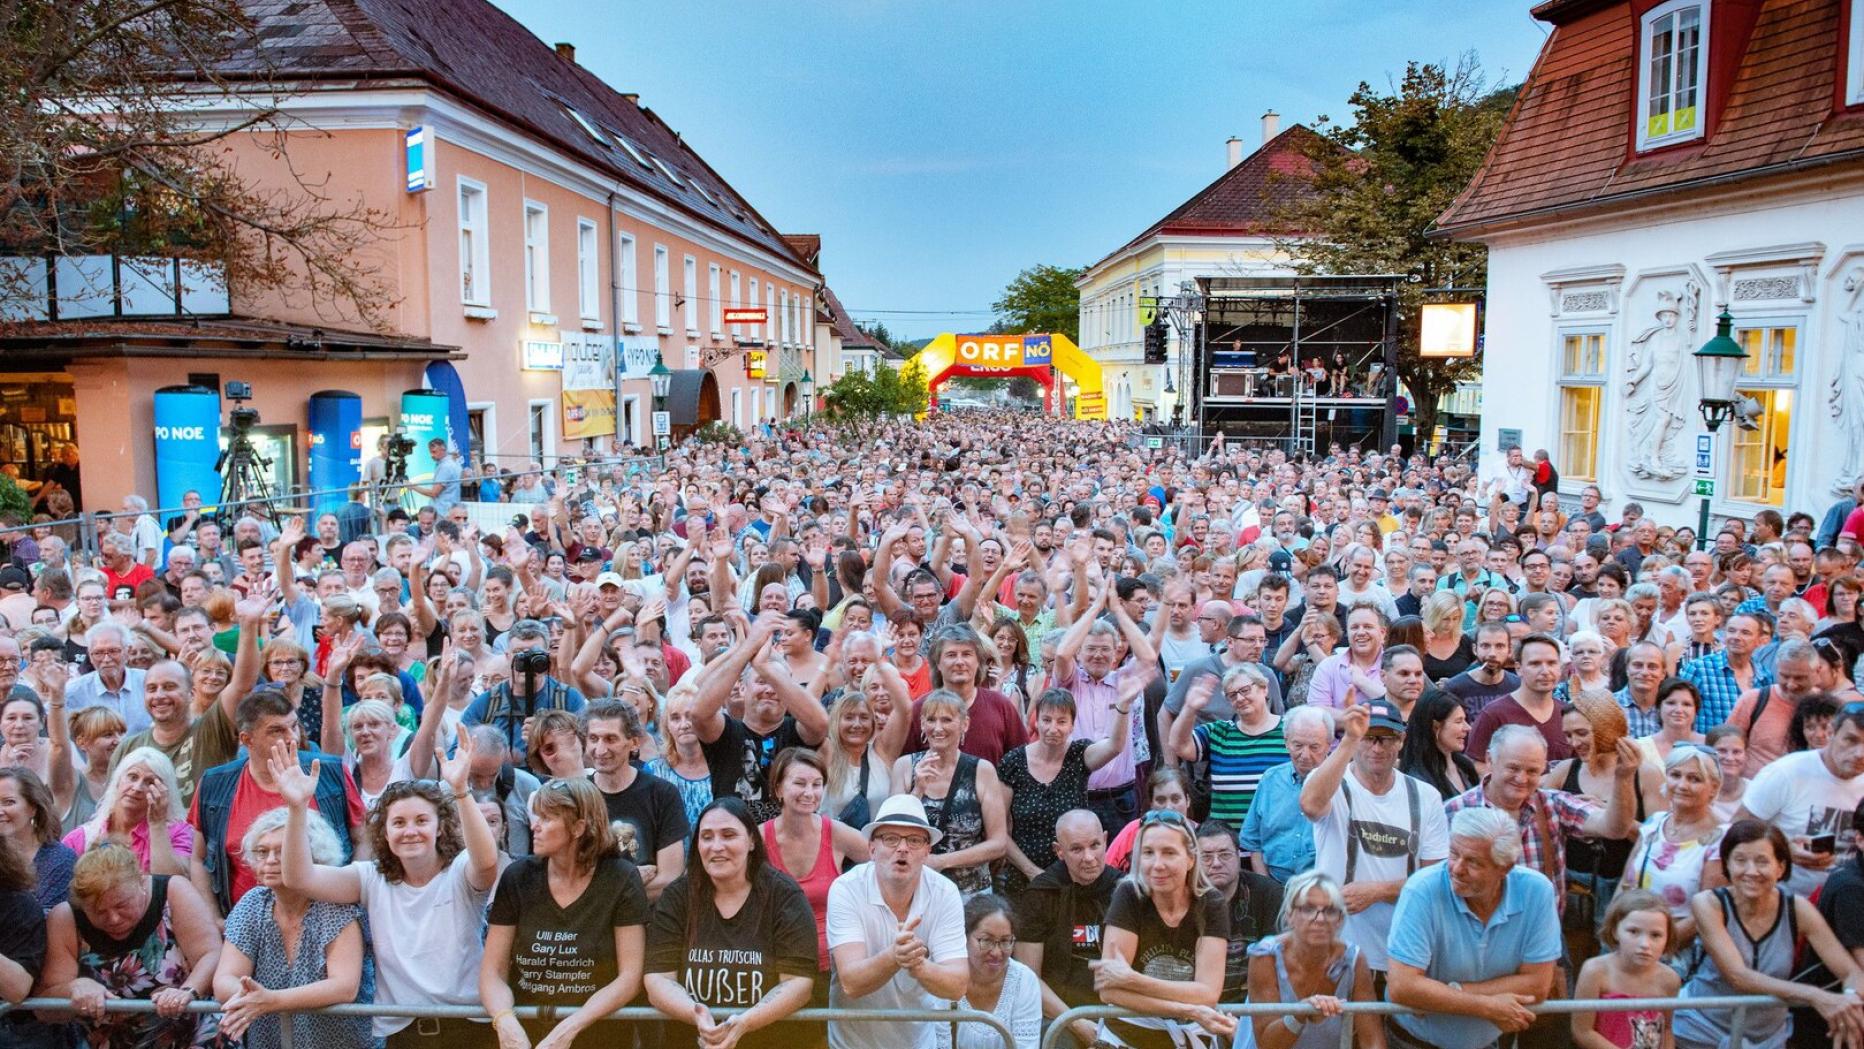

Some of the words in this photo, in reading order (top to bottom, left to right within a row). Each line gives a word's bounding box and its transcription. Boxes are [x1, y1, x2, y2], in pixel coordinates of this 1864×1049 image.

[960, 341, 1019, 361] ORF
[1026, 341, 1050, 358] NÖ
[172, 426, 205, 440] NOE
[536, 930, 553, 940] Ulli
[531, 942, 557, 956] Gary
[558, 944, 578, 954] Lux
[516, 954, 547, 966] Harald
[549, 957, 595, 967] Fendrich
[688, 949, 714, 963] OLLAS
[717, 949, 762, 965] TRUTSCHN
[545, 969, 592, 982] Stampfer
[557, 983, 596, 994] Ambros
